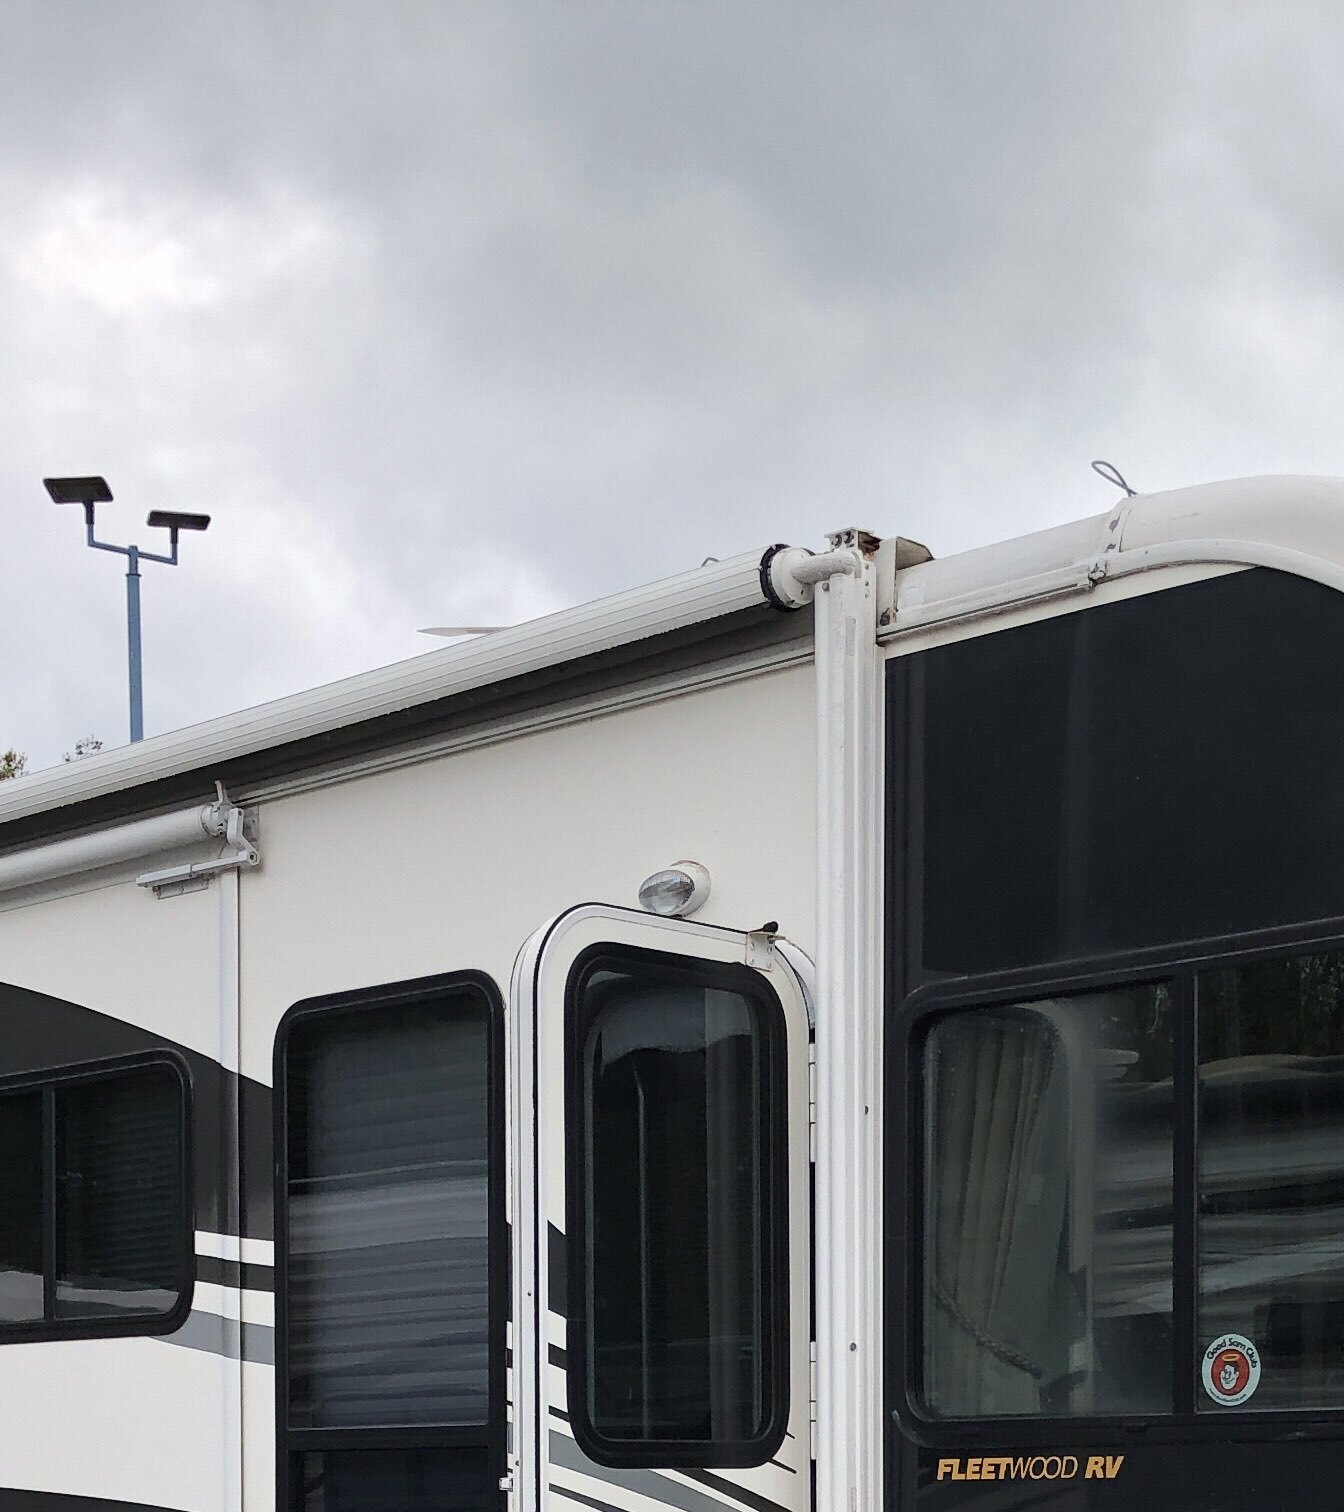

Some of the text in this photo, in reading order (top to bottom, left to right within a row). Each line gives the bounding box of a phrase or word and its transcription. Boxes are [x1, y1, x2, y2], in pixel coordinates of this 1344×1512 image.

[1206, 1337, 1258, 1369] Good Sam Club
[936, 1455, 1125, 1481] FLEETWOOD RV
